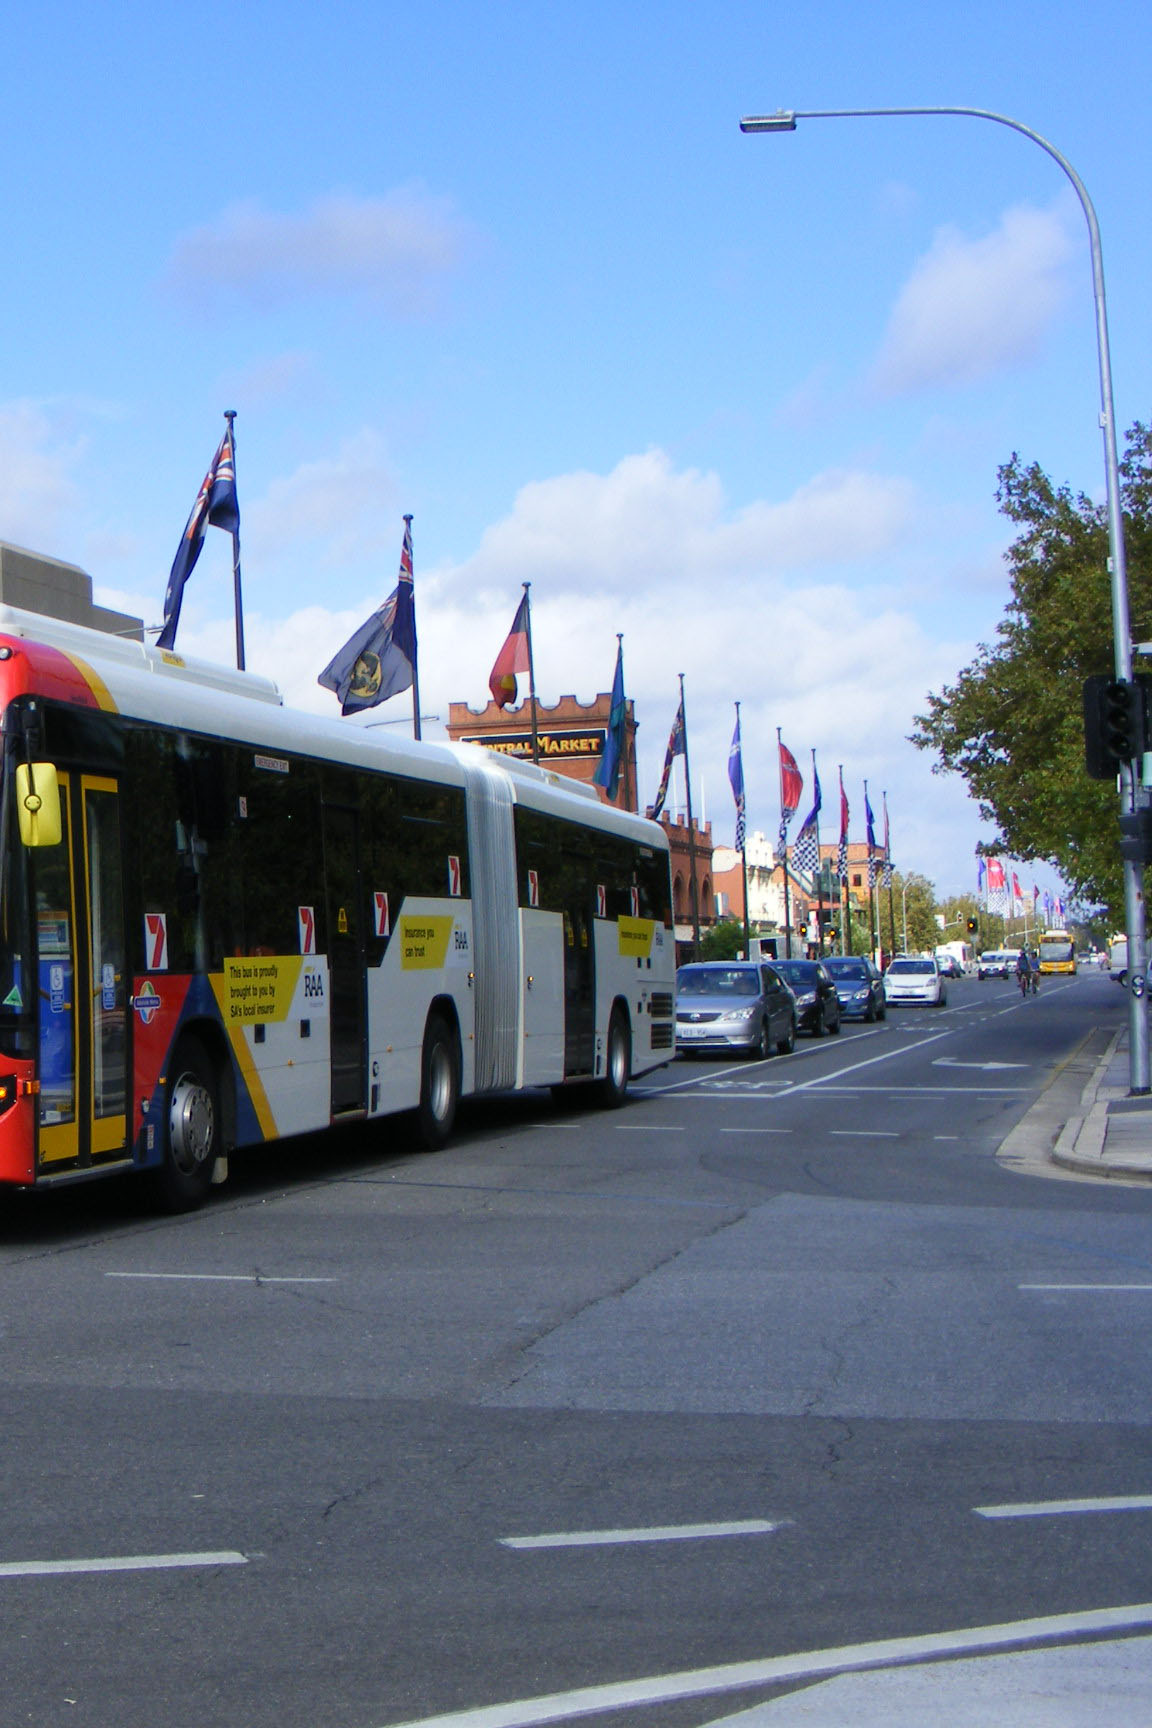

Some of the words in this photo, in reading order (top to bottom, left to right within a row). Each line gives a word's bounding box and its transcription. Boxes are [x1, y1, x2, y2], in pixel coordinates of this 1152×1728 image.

[537, 736, 600, 754] MARKET
[146, 915, 165, 968] 7
[230, 965, 241, 978] This
[243, 966, 252, 978] bus
[259, 964, 278, 978] proudly
[230, 985, 252, 1000] brought
[258, 987, 268, 998] you
[269, 984, 275, 997] by
[304, 974, 324, 997] RAA
[231, 1005, 242, 1018] SA's
[243, 1004, 256, 1016] local
[256, 1004, 275, 1015] insurer
